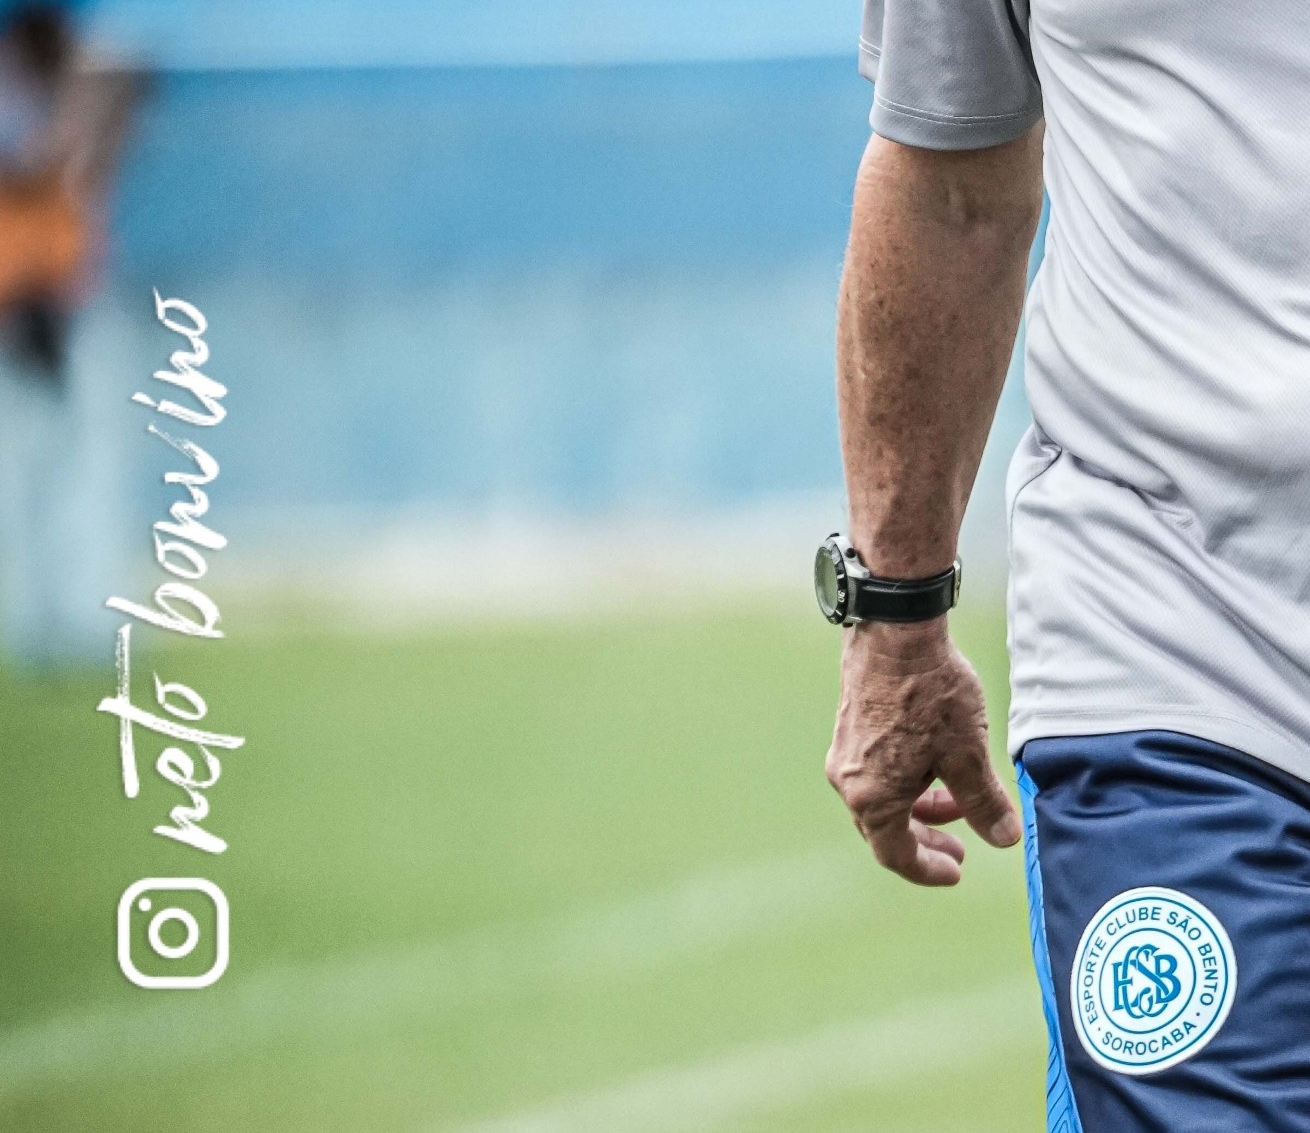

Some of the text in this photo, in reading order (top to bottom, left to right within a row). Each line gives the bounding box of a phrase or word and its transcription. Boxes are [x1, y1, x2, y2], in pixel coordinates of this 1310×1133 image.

[1083, 906, 1219, 1025] ESPORTE CLUBE SÃO BENTO
[1102, 1020, 1198, 1056] SOROCABA
